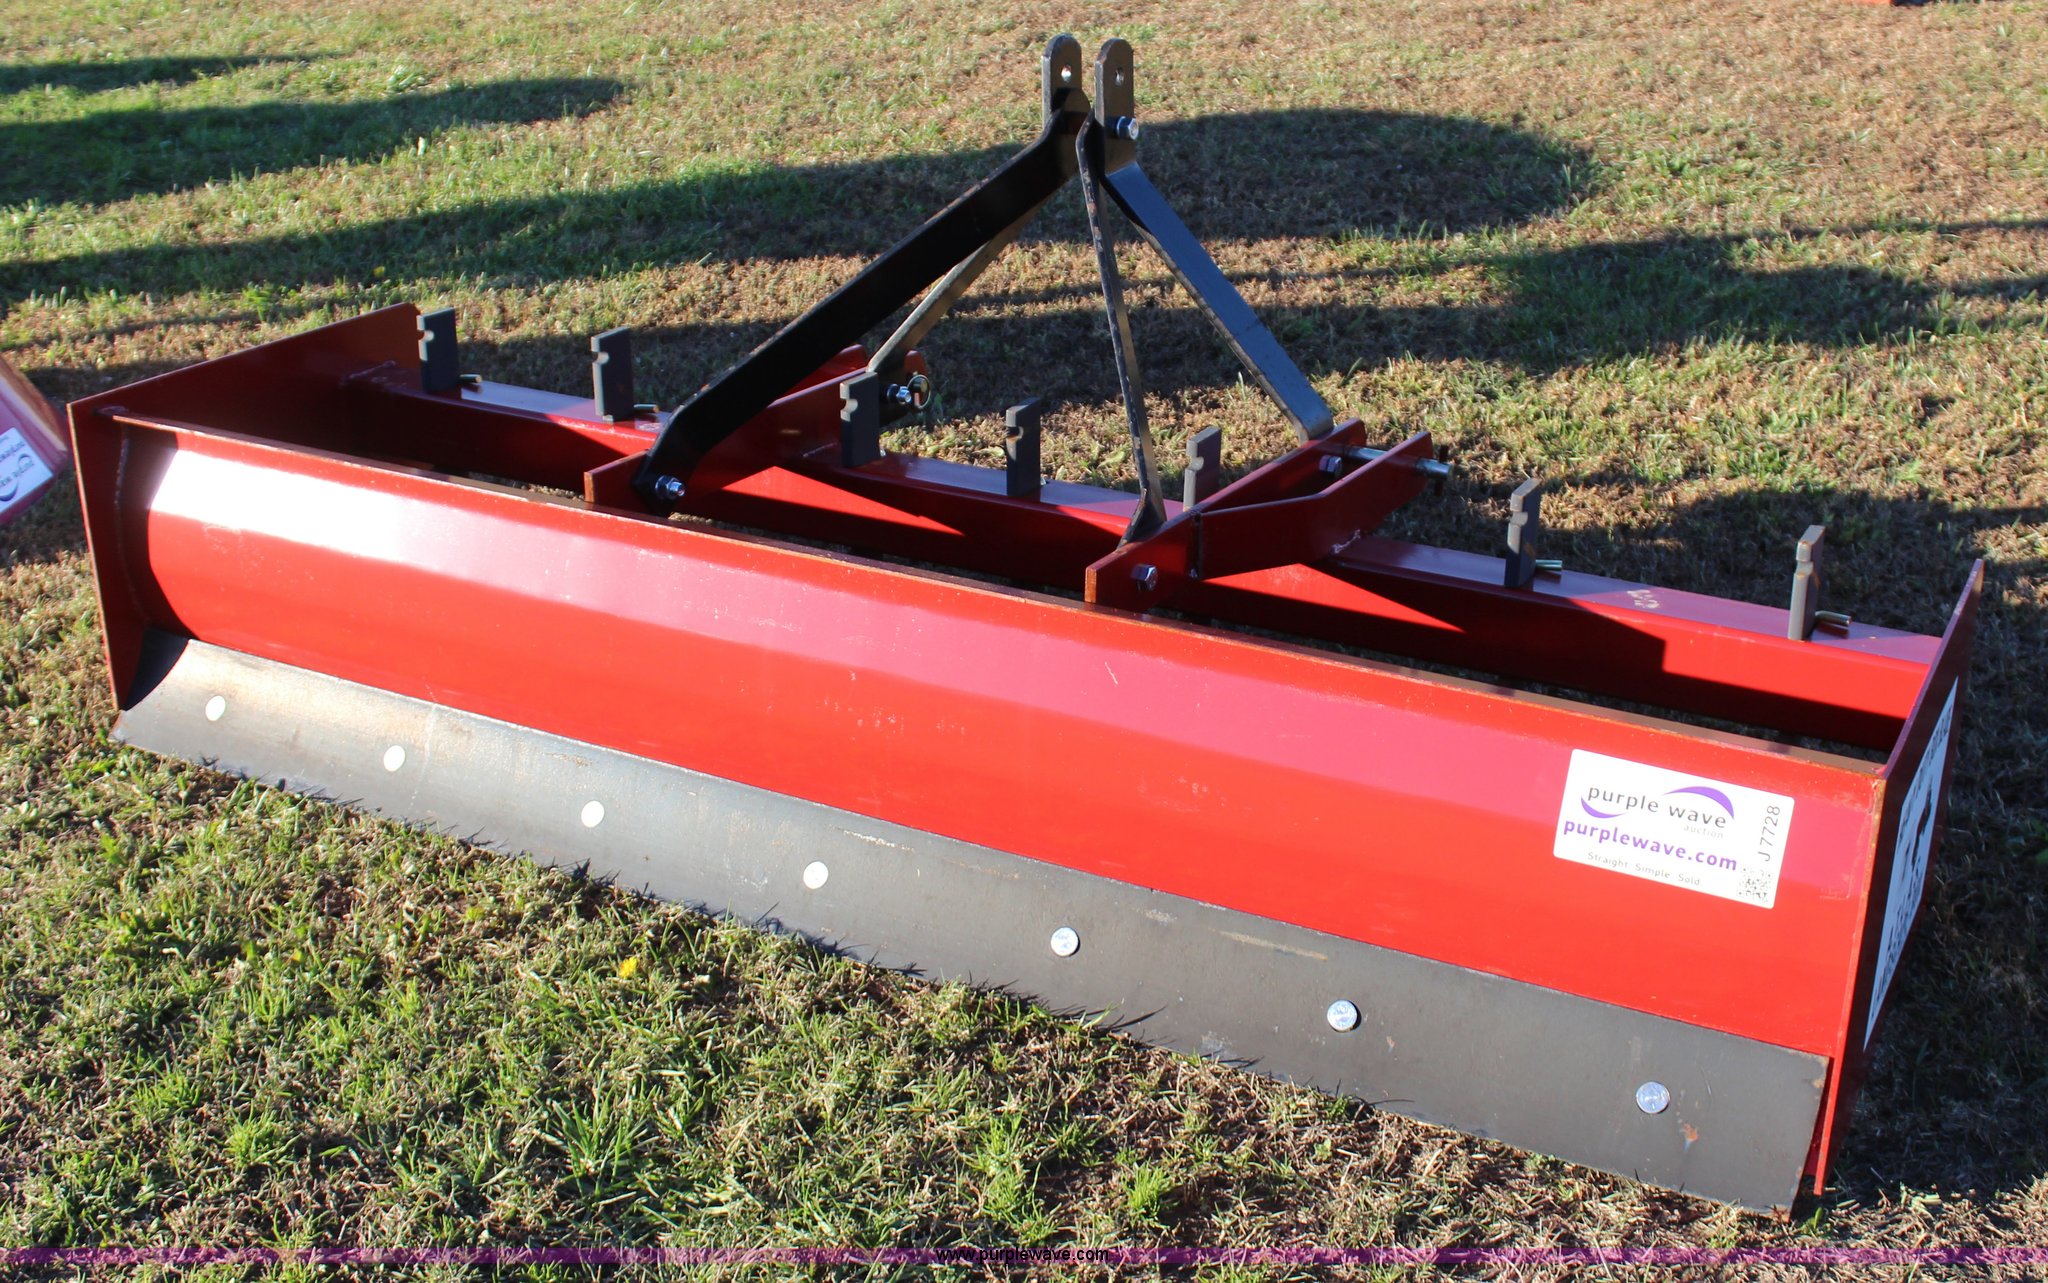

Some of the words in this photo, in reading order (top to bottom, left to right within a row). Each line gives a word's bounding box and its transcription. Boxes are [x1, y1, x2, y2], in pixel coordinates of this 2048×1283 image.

[1587, 786, 1660, 813] purple
[1668, 805, 1727, 829] wave
[1563, 820, 1738, 871] purplewave.com
[1683, 824, 1724, 840] auction
